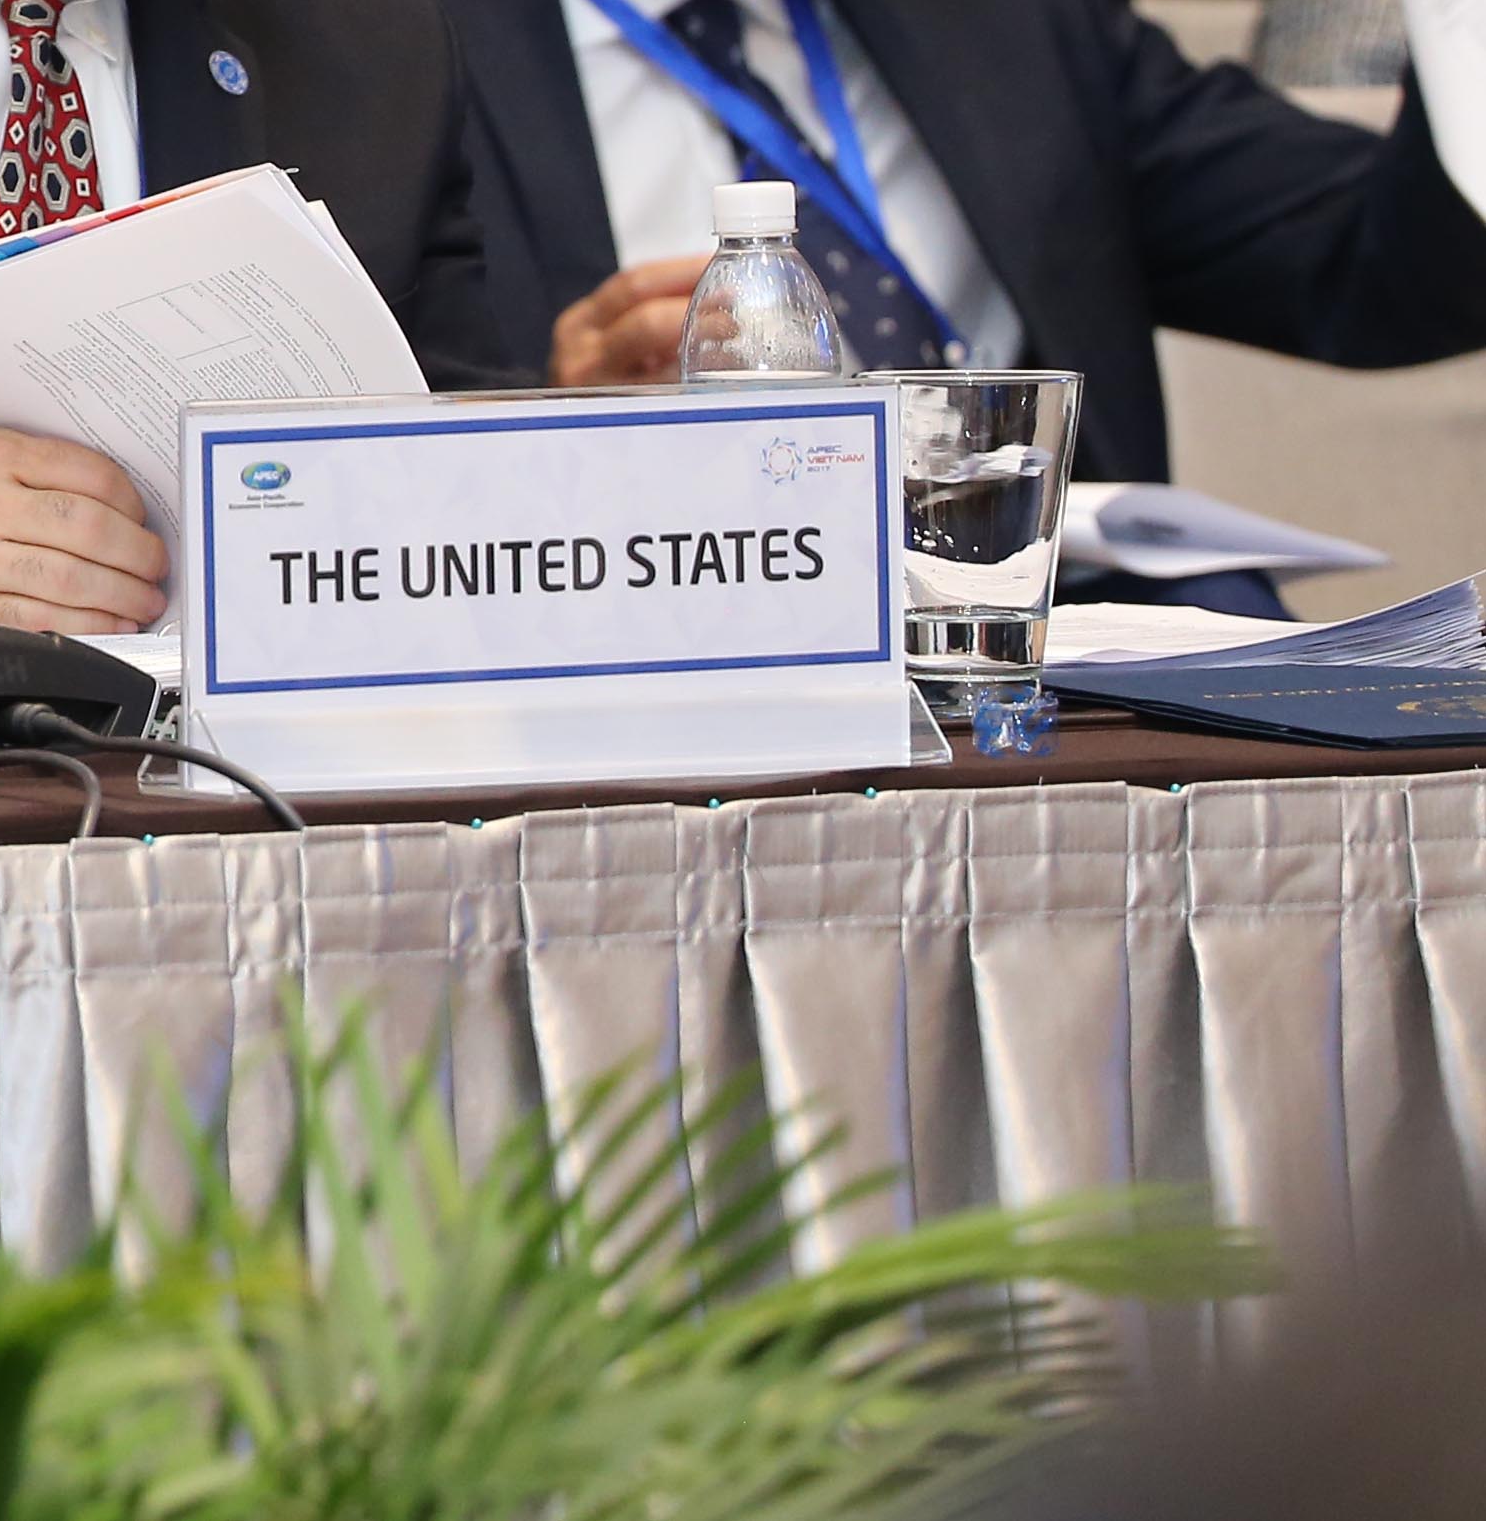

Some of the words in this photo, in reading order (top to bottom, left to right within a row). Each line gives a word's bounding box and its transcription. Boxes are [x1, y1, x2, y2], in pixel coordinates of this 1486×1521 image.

[837, 454, 865, 463] NAM
[270, 548, 380, 605] THE
[400, 537, 607, 600] UNITED
[626, 526, 825, 588] STATES
